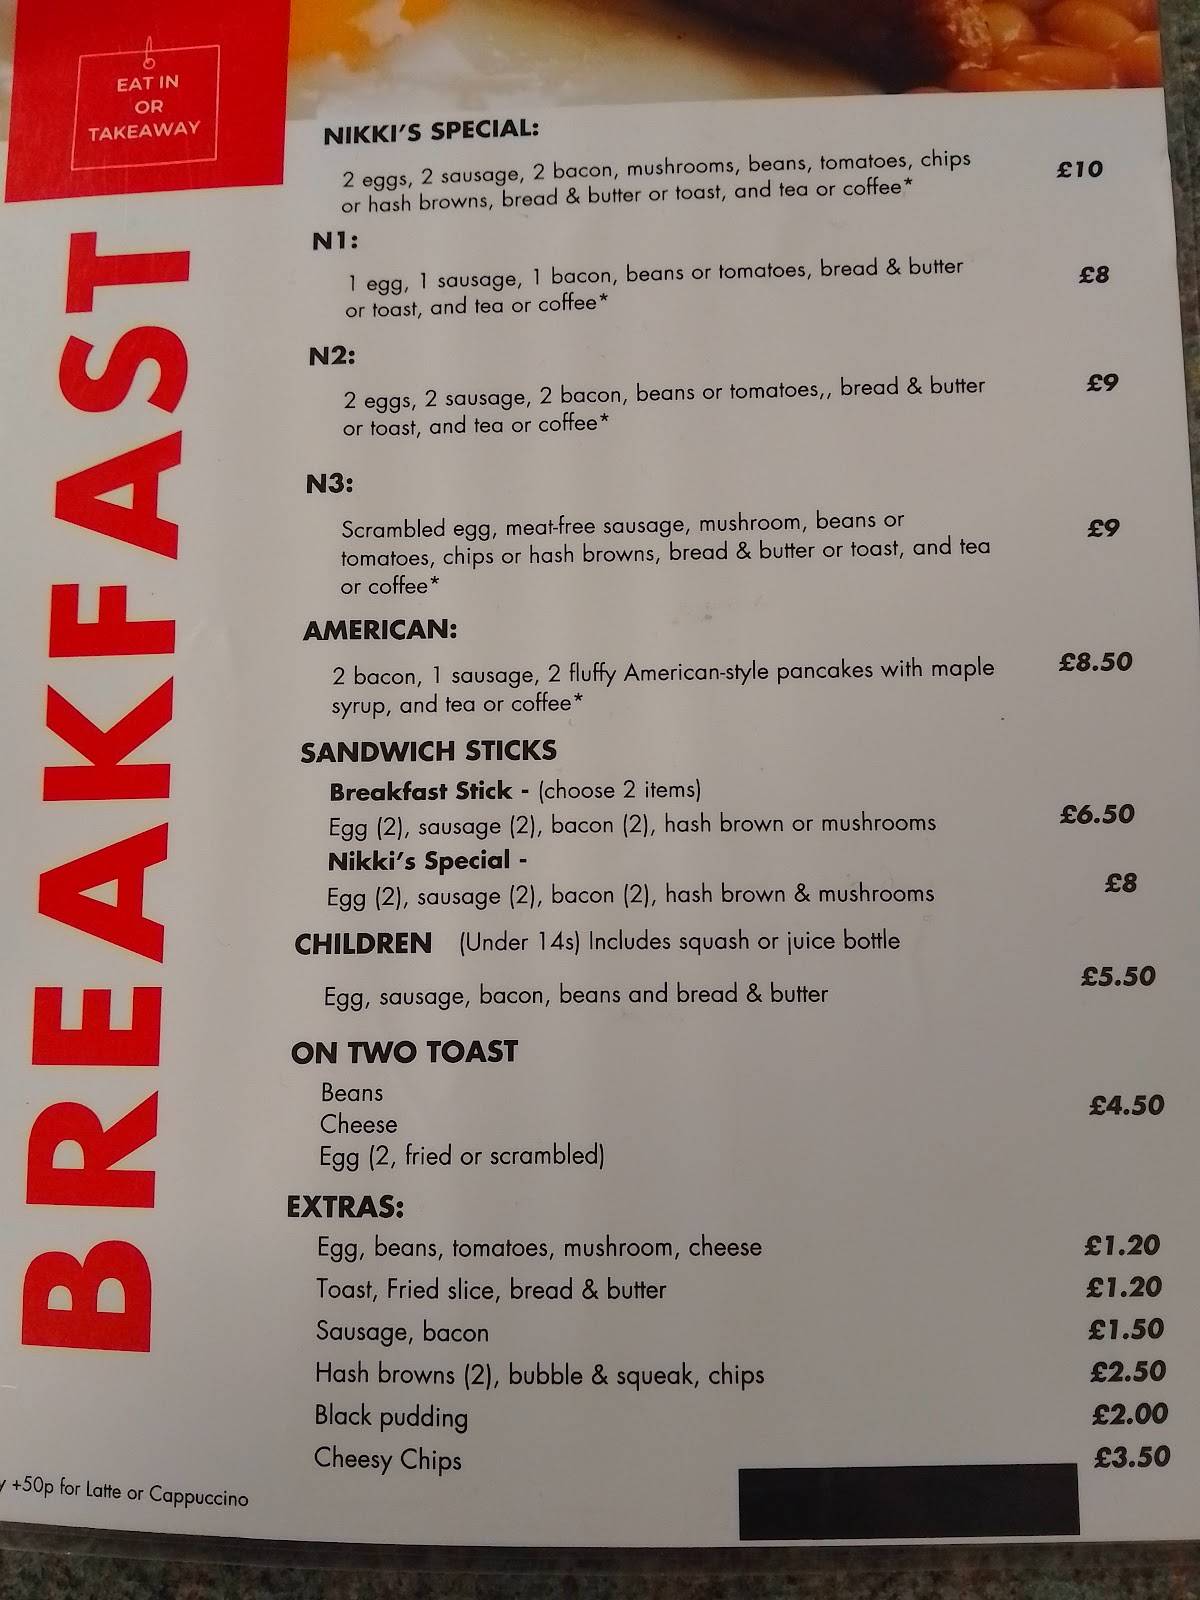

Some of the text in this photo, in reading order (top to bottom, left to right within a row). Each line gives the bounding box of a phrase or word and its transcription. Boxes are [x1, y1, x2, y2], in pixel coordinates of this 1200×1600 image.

[117, 74, 179, 92] EAT IN
[134, 99, 164, 115] OR
[88, 120, 201, 142] TAKEAWAY
[324, 119, 539, 145] NIKKI'S SPECIAL:
[343, 148, 970, 191] 2 eggs, 2 sausage, 2 bacon, mushrooms, beans, tomatoes, chips
[1057, 160, 1103, 178] £10
[313, 231, 357, 250] N1:
[350, 256, 964, 296] 1 egg, 1 sausage, 1 bacon, beans or tomatoes, bread & butter
[1079, 266, 1109, 283] £8
[310, 345, 355, 366] N2:
[1086, 373, 1119, 391] £9
[343, 425, 363, 436] or
[371, 420, 420, 439] toast,
[430, 414, 465, 434] and
[474, 418, 503, 433] tea
[512, 421, 531, 432] or
[307, 473, 353, 493] N3:
[342, 510, 904, 541] Scrambled egg, meat-free sausage, mushroom, beans or
[1088, 519, 1120, 537] £9
[341, 583, 361, 594] or
[303, 619, 456, 641] AMERICAN:
[333, 656, 994, 688] 2 bacon, 1 sausage, 2 fluffy American-style pancakes with maple
[1059, 652, 1132, 672] £8.50
[332, 702, 391, 719] syrup,
[400, 693, 437, 713] and
[446, 697, 475, 712] tea
[484, 700, 504, 712] or
[301, 739, 557, 763] SANDWICH STICKS
[22, 232, 190, 1352] BREAKFAST
[331, 781, 448, 801] Breakfast
[456, 780, 512, 800] Stick
[540, 779, 615, 804] (choose
[624, 780, 635, 798] 2
[646, 779, 700, 802] items)
[1060, 804, 1135, 824] £6.50
[330, 811, 936, 841] Egg (2), sausage (2), bacon (2), hash brown or mushrooms
[329, 850, 415, 871] Nikki's
[425, 849, 509, 875] Special
[1105, 873, 1137, 893] £8
[295, 928, 900, 956] CHILDREN (Under 14s) Includes squash or juice bottle
[1081, 966, 1156, 986] £5.50
[325, 982, 828, 1012] Egg, sausage, bacon, beans and bread & butter
[292, 1040, 518, 1064] ON TWO TOAST
[322, 1082, 383, 1102] Beans
[1089, 1094, 1165, 1115] £4.50
[321, 1112, 397, 1134] Cheese
[320, 1142, 603, 1172] Egg (2, fried or scrambled)
[288, 1195, 403, 1218] EXTRAS:
[319, 1234, 762, 1263] Egg, beans, tomatoes, mushroom, cheese
[1084, 1234, 1160, 1256] £1.20
[1086, 1276, 1162, 1298] £1.20
[317, 1319, 488, 1347] Sausage, bacon
[1088, 1318, 1164, 1340] £1.50
[317, 1360, 764, 1391] Hash browns (2), bubble & squeak, chips
[1090, 1360, 1166, 1382] £2.50
[316, 1402, 467, 1434] Black pudding
[1092, 1402, 1168, 1425] £2.00
[315, 1445, 461, 1476] Cheesy Chips
[1094, 1445, 1171, 1468] £3.50
[12, 1476, 53, 1498] +50p
[60, 1477, 80, 1495] for
[87, 1480, 121, 1499] Latte
[127, 1489, 144, 1500] or
[150, 1485, 248, 1508] Cappuccino
